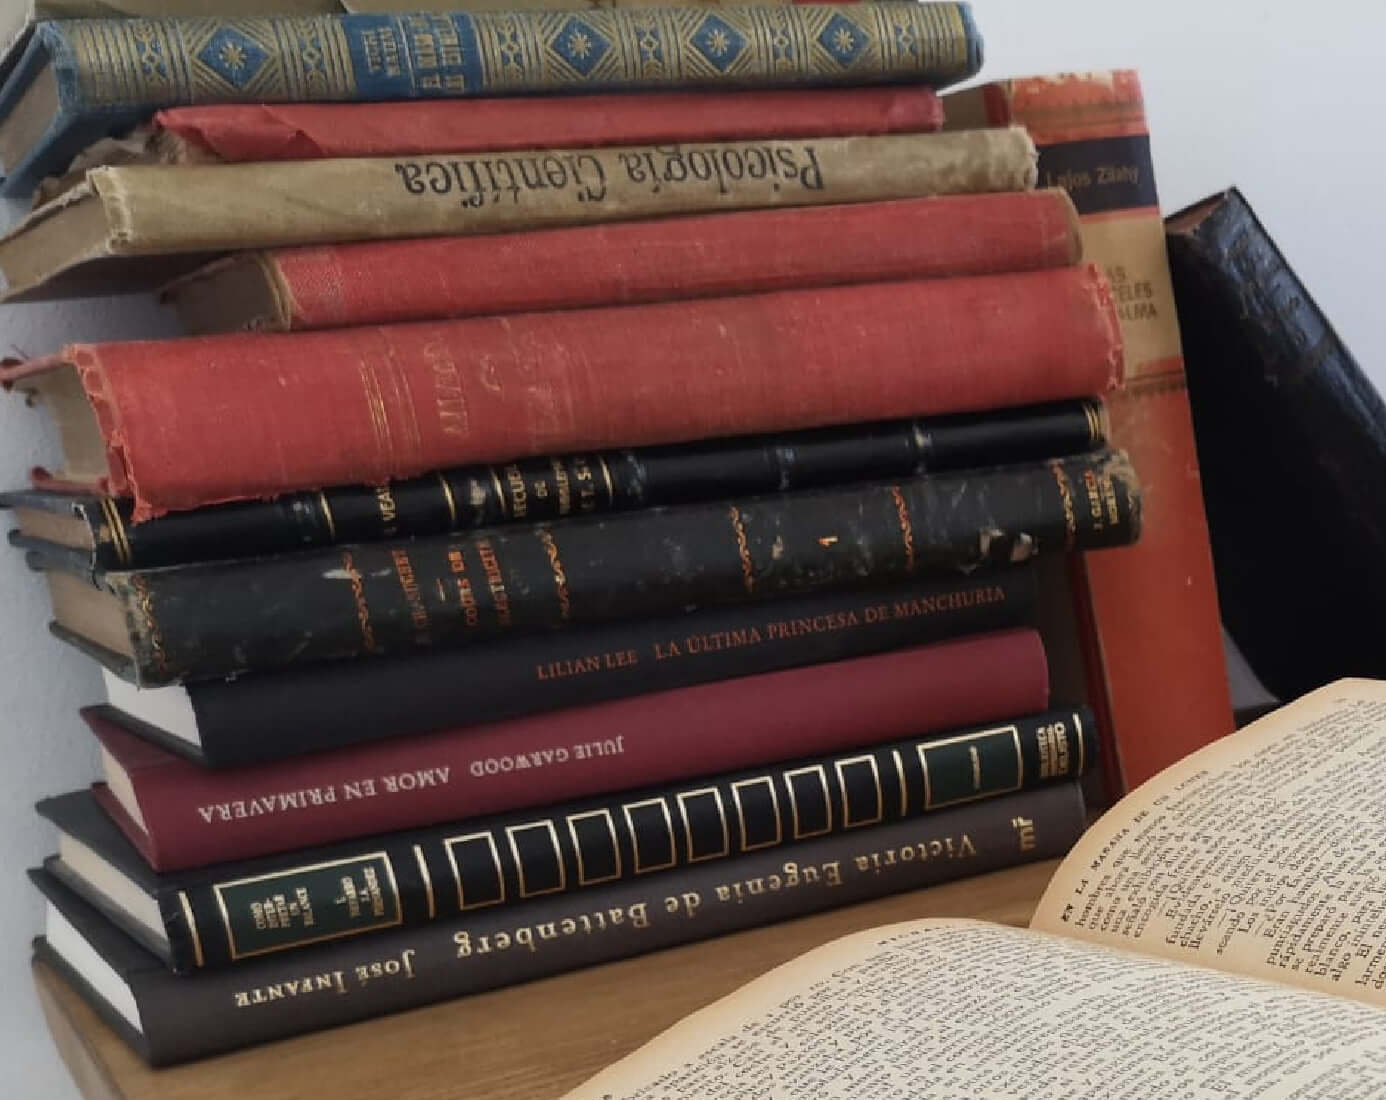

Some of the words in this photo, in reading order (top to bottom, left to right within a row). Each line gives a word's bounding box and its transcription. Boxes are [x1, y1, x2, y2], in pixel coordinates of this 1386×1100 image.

[618, 143, 826, 194] Psicología
[536, 655, 599, 680] LILIAN
[604, 648, 639, 671] LEE
[654, 641, 681, 661] LA
[767, 611, 858, 640] PRINCESA
[864, 604, 889, 624] DE
[894, 585, 1006, 619] MANCHURIA
[470, 747, 569, 777] GARWOOD
[575, 735, 625, 761] JULIE
[343, 779, 378, 800] EN
[382, 766, 450, 794] AMOR
[198, 784, 336, 825] PRIMAVERA
[856, 833, 977, 875] Victoria
[716, 860, 845, 904] Eugenia
[664, 891, 701, 919] de
[453, 902, 652, 959] Battenberg
